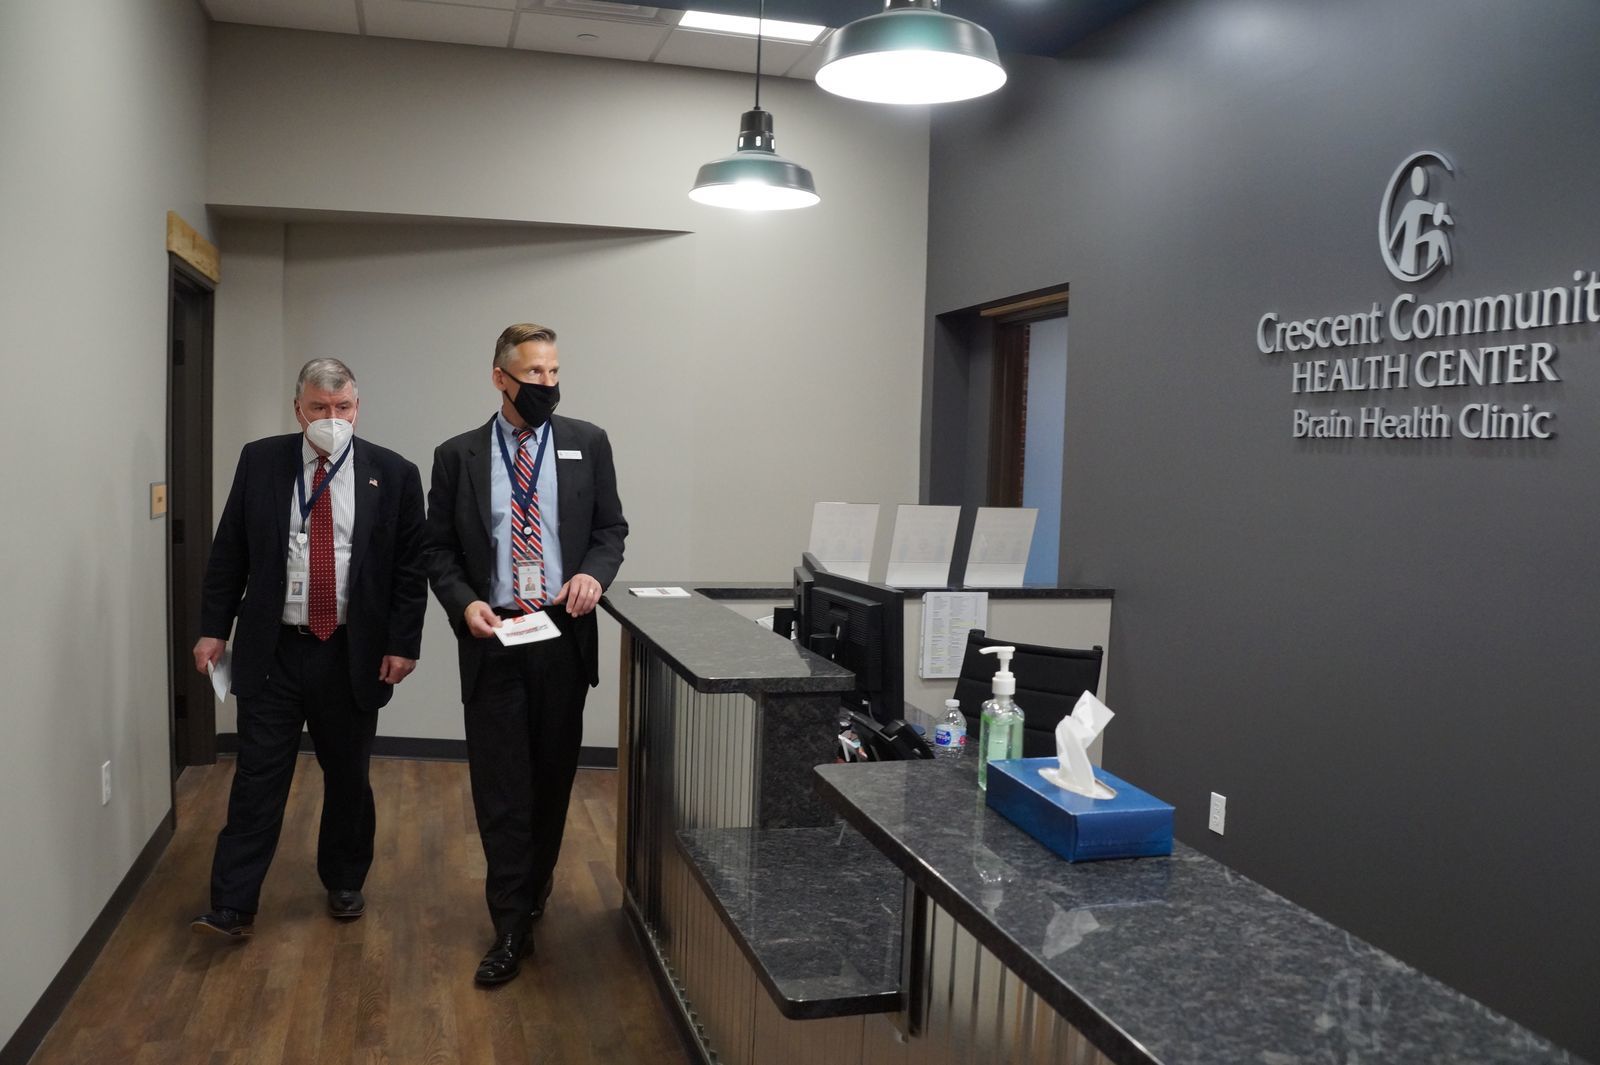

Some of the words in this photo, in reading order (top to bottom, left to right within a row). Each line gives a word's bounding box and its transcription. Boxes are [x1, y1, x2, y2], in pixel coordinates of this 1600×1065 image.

[1256, 302, 1385, 354] Crescent
[1389, 270, 1600, 341] Communit
[1292, 353, 1409, 393] HEALTH
[1414, 342, 1559, 387] CENTER
[1292, 408, 1353, 438] Brain
[1358, 405, 1451, 438] Health
[1458, 403, 1553, 438] Clinic
